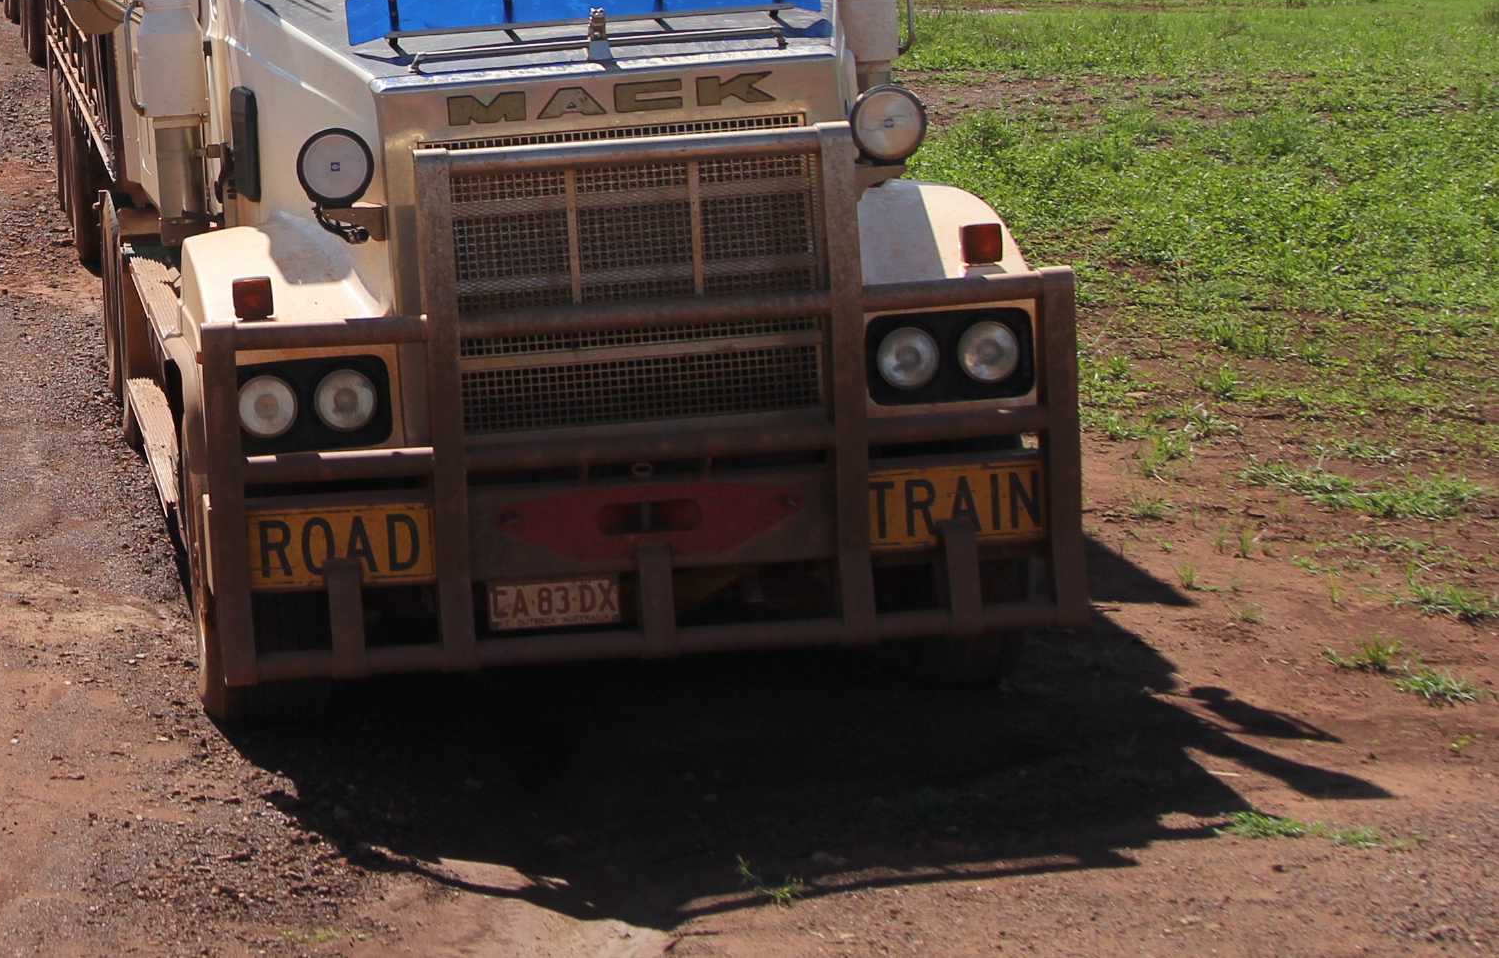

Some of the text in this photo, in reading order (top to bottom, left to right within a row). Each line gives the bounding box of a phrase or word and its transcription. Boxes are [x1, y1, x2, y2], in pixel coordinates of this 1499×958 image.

[447, 71, 776, 126] MACK
[869, 471, 1041, 538] TRAIN
[258, 513, 420, 578] ROAD
